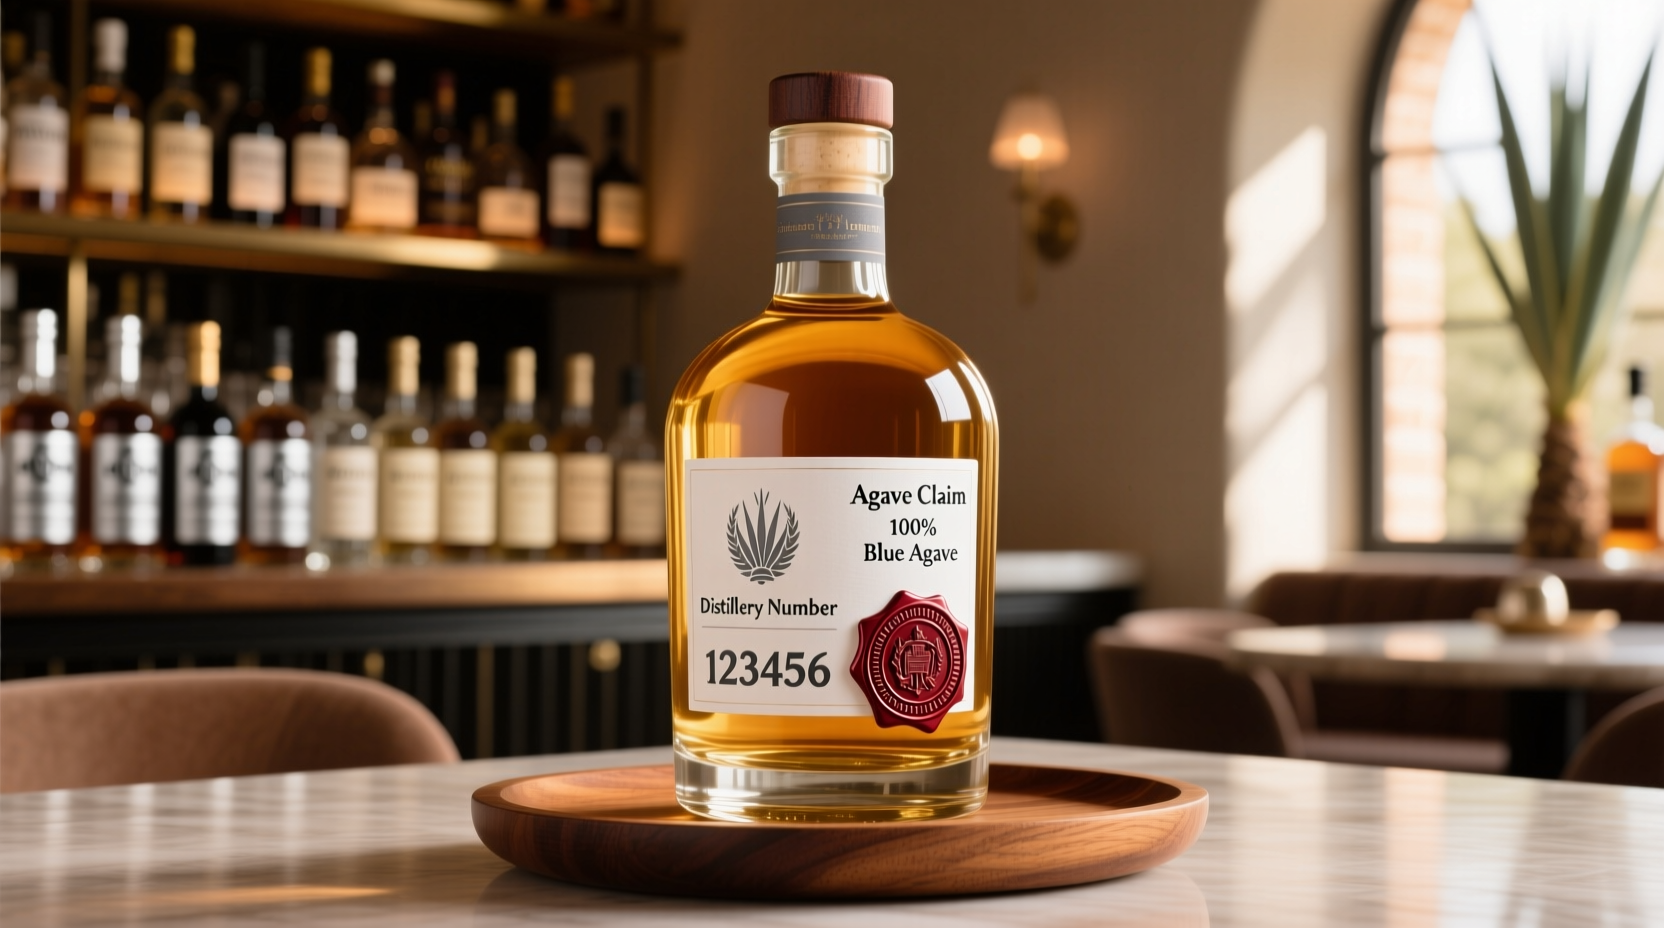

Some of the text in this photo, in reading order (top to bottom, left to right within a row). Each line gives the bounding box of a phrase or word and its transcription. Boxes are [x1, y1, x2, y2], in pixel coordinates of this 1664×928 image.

[850, 484, 967, 511] Agave Claim
[890, 518, 937, 536] 100%
[864, 543, 959, 567] Blue Agave
[700, 597, 838, 620] Distillery Number
[706, 649, 831, 687] 123456
